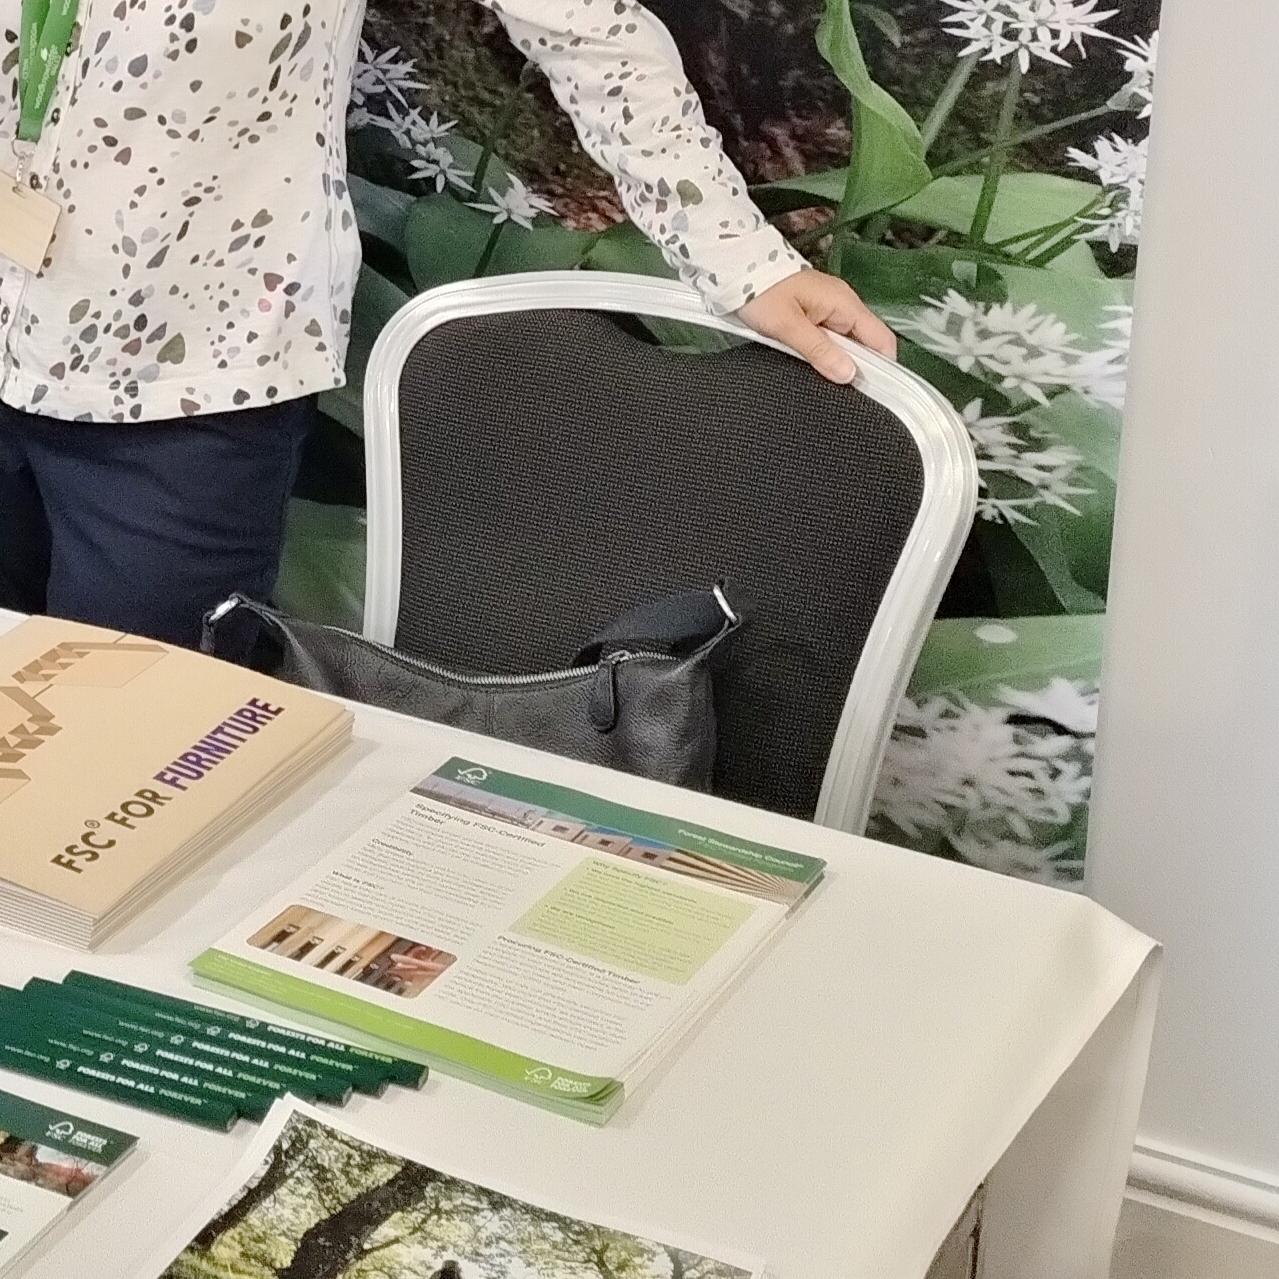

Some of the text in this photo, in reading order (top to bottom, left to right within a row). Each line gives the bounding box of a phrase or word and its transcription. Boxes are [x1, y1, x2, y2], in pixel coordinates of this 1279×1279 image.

[105, 787, 174, 832] FOR
[152, 696, 285, 793] FURNITURE
[410, 808, 446, 827] Timber
[414, 802, 546, 848] Specifying FSC-Certified
[497, 934, 543, 954] Procuring
[192, 1041, 231, 1058] FORESTS
[230, 1052, 251, 1064] FOR
[251, 1057, 270, 1069] ALL
[228, 1032, 267, 1049] FORESTS
[267, 1043, 287, 1055] FOR
[288, 1048, 307, 1060] ALL
[121, 1058, 160, 1076] FORESTS
[159, 1069, 180, 1082] FOR
[180, 1075, 199, 1087] ALL
[155, 1049, 194, 1067] FORESTS
[194, 1059, 214, 1072] FOR
[214, 1066, 234, 1078] ALL
[77, 1065, 116, 1082] FORESTS
[116, 1076, 136, 1089] FOR
[136, 1082, 155, 1094] ALL
